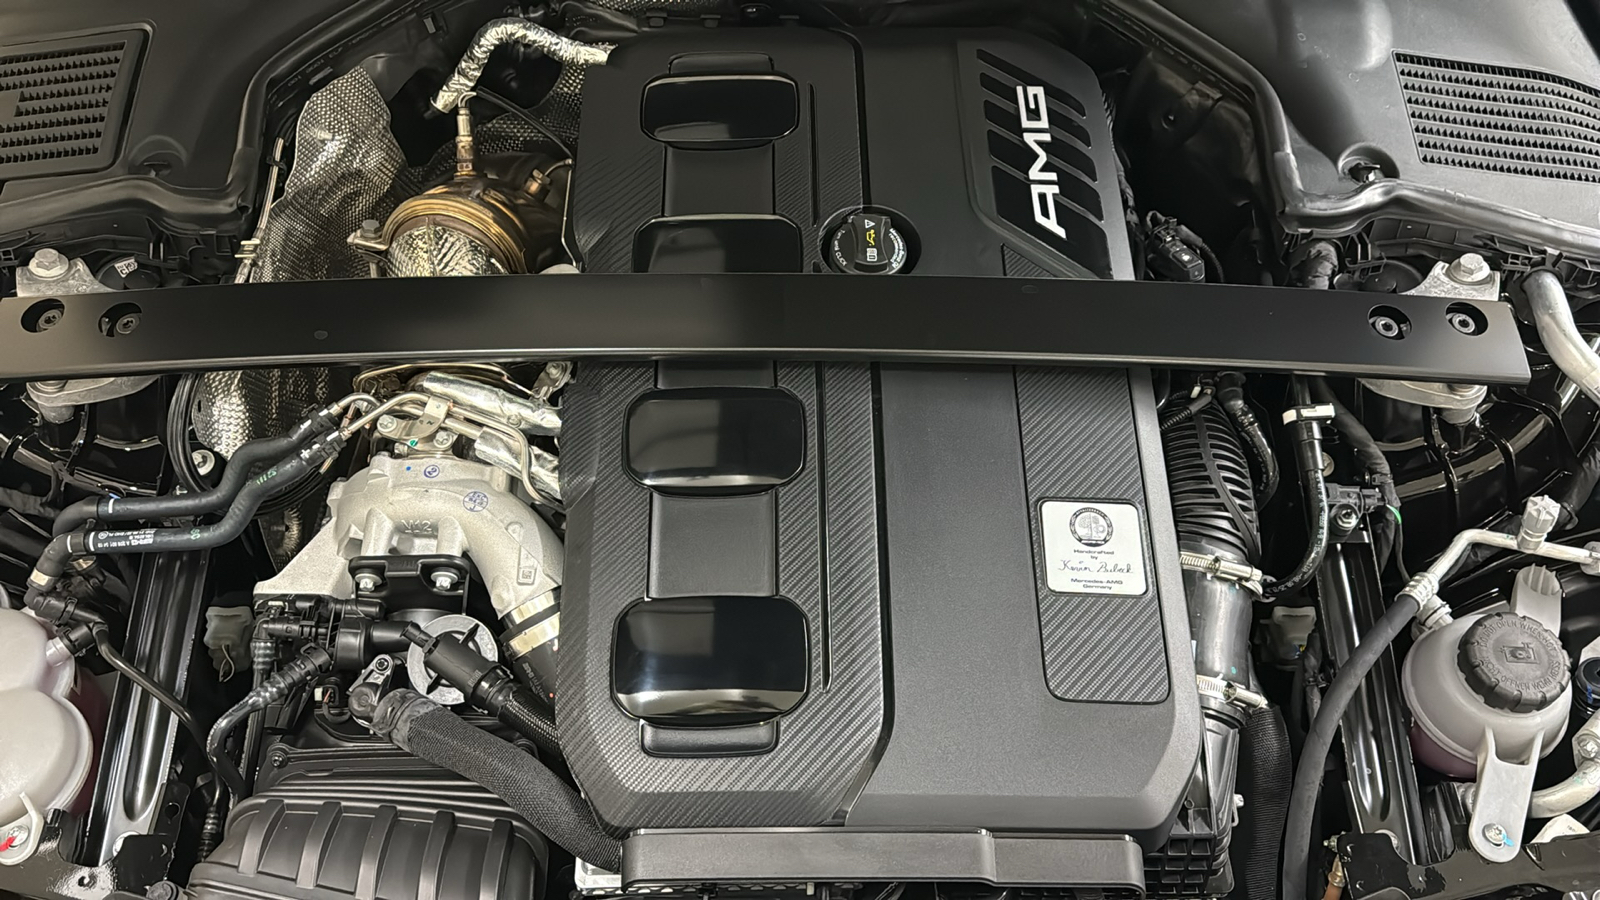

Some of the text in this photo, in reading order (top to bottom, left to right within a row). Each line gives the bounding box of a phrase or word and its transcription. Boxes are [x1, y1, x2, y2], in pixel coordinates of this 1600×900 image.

[1016, 86, 1067, 240] AMG
[835, 251, 847, 267] CLICK
[1496, 620, 1517, 629] OPEN
[1519, 621, 1544, 640] WHEN
